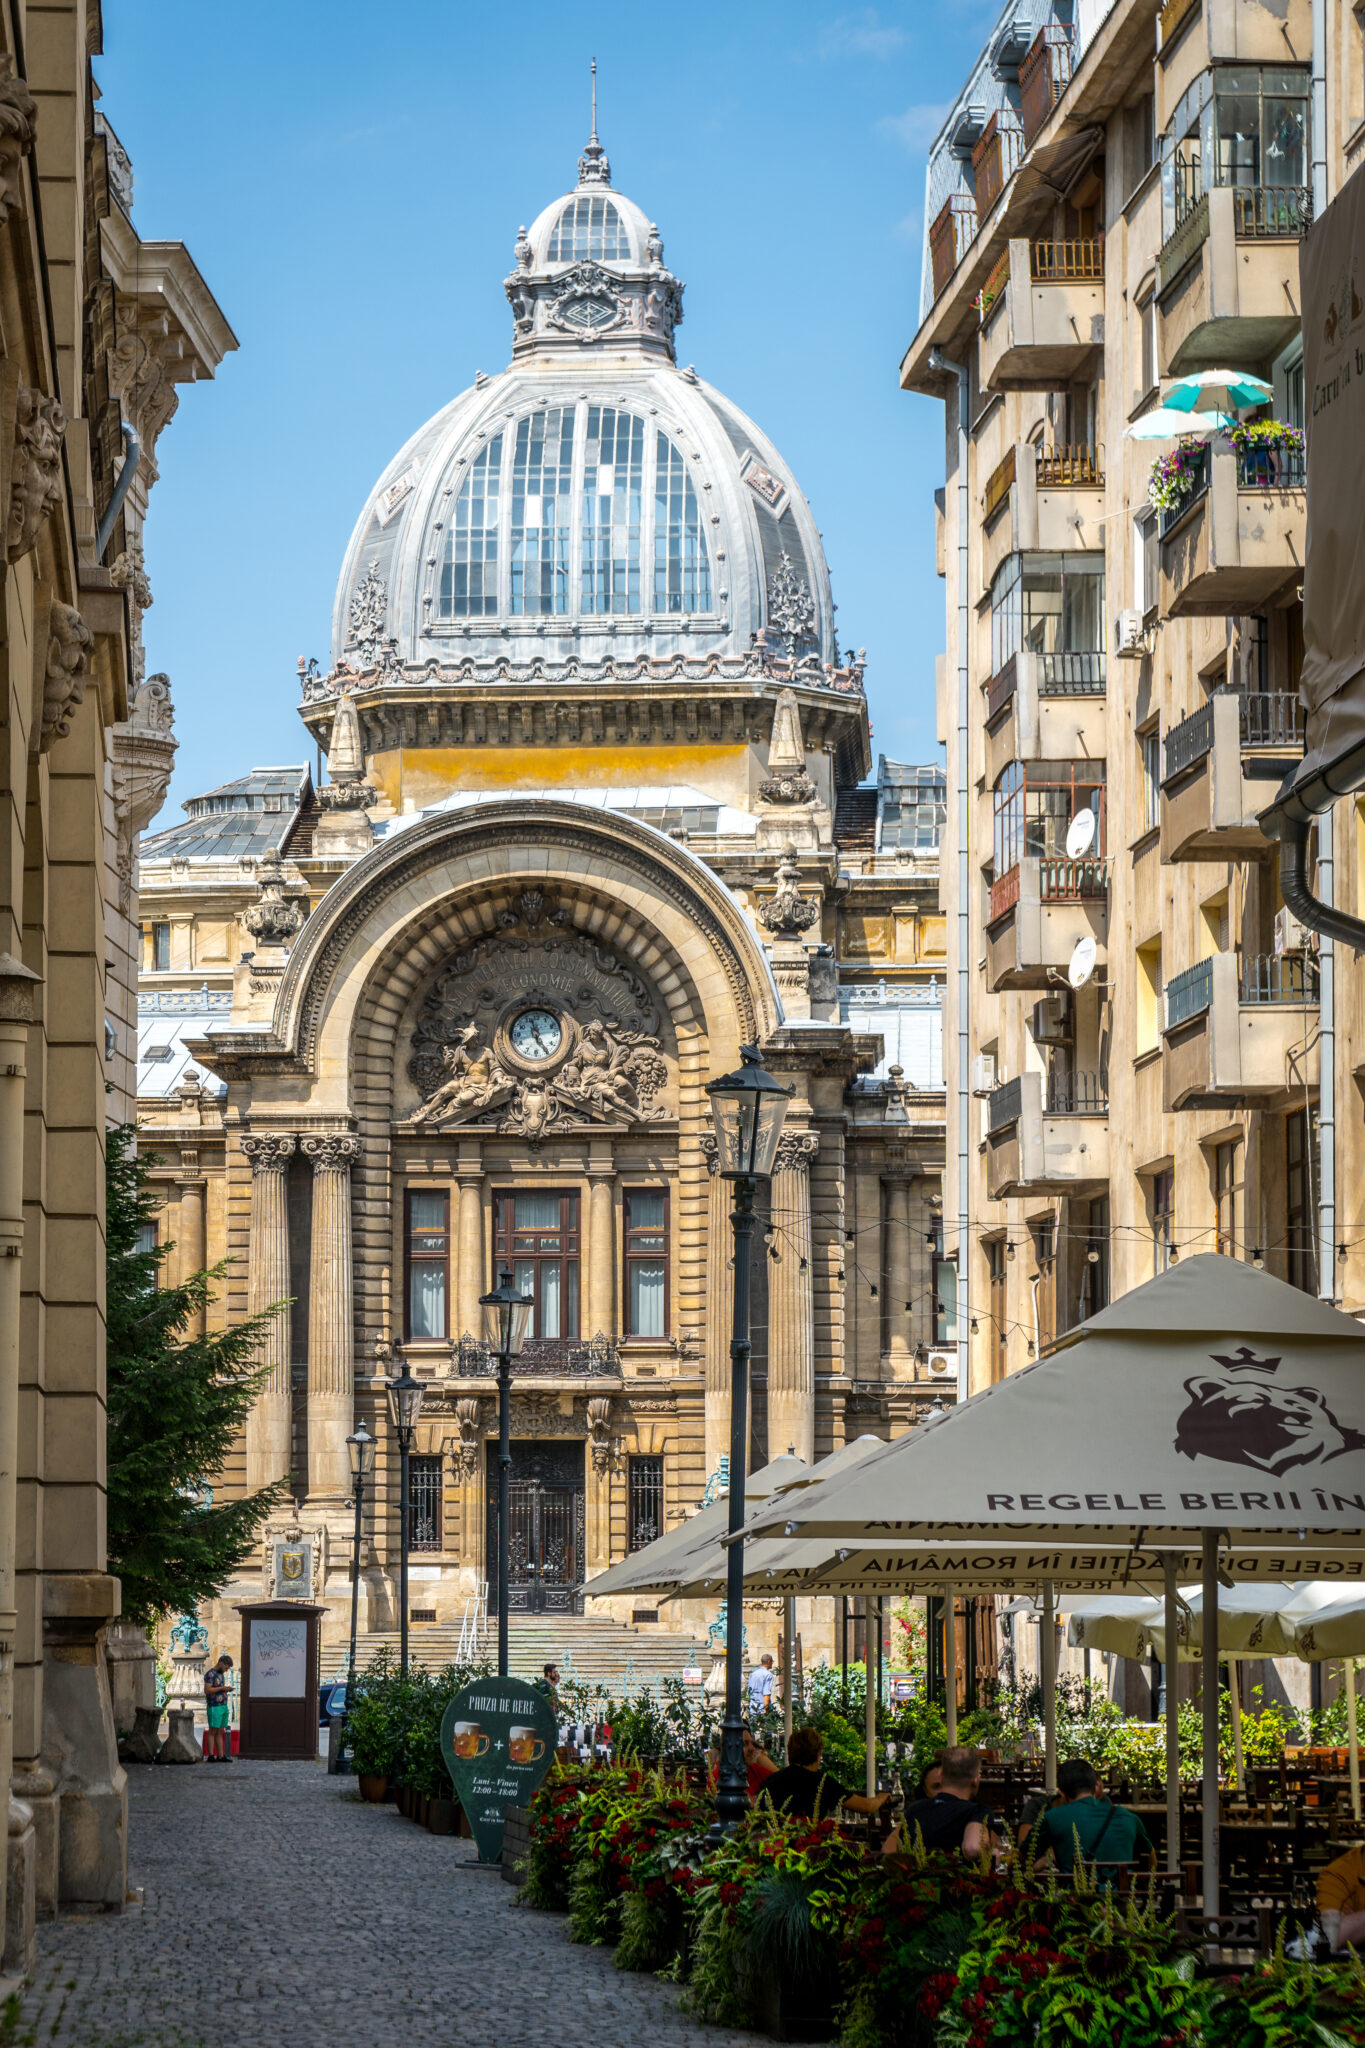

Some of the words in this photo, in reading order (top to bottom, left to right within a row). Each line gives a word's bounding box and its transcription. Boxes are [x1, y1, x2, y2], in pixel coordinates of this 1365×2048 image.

[1354, 345, 1365, 376] b
[502, 973, 575, 993] ECONOMIE
[987, 1494, 1167, 1511] REGELE
[1180, 1492, 1302, 1511] BERII
[1310, 1487, 1365, 1512] ÎN
[468, 1695, 497, 1712] PAUZA
[499, 1698, 510, 1713] DE
[512, 1699, 535, 1715] BERE
[472, 1776, 490, 1785] Luni
[497, 1778, 519, 1788] Vineri
[472, 1786, 492, 1794] 12:00
[498, 1788, 518, 1796] 18:00
